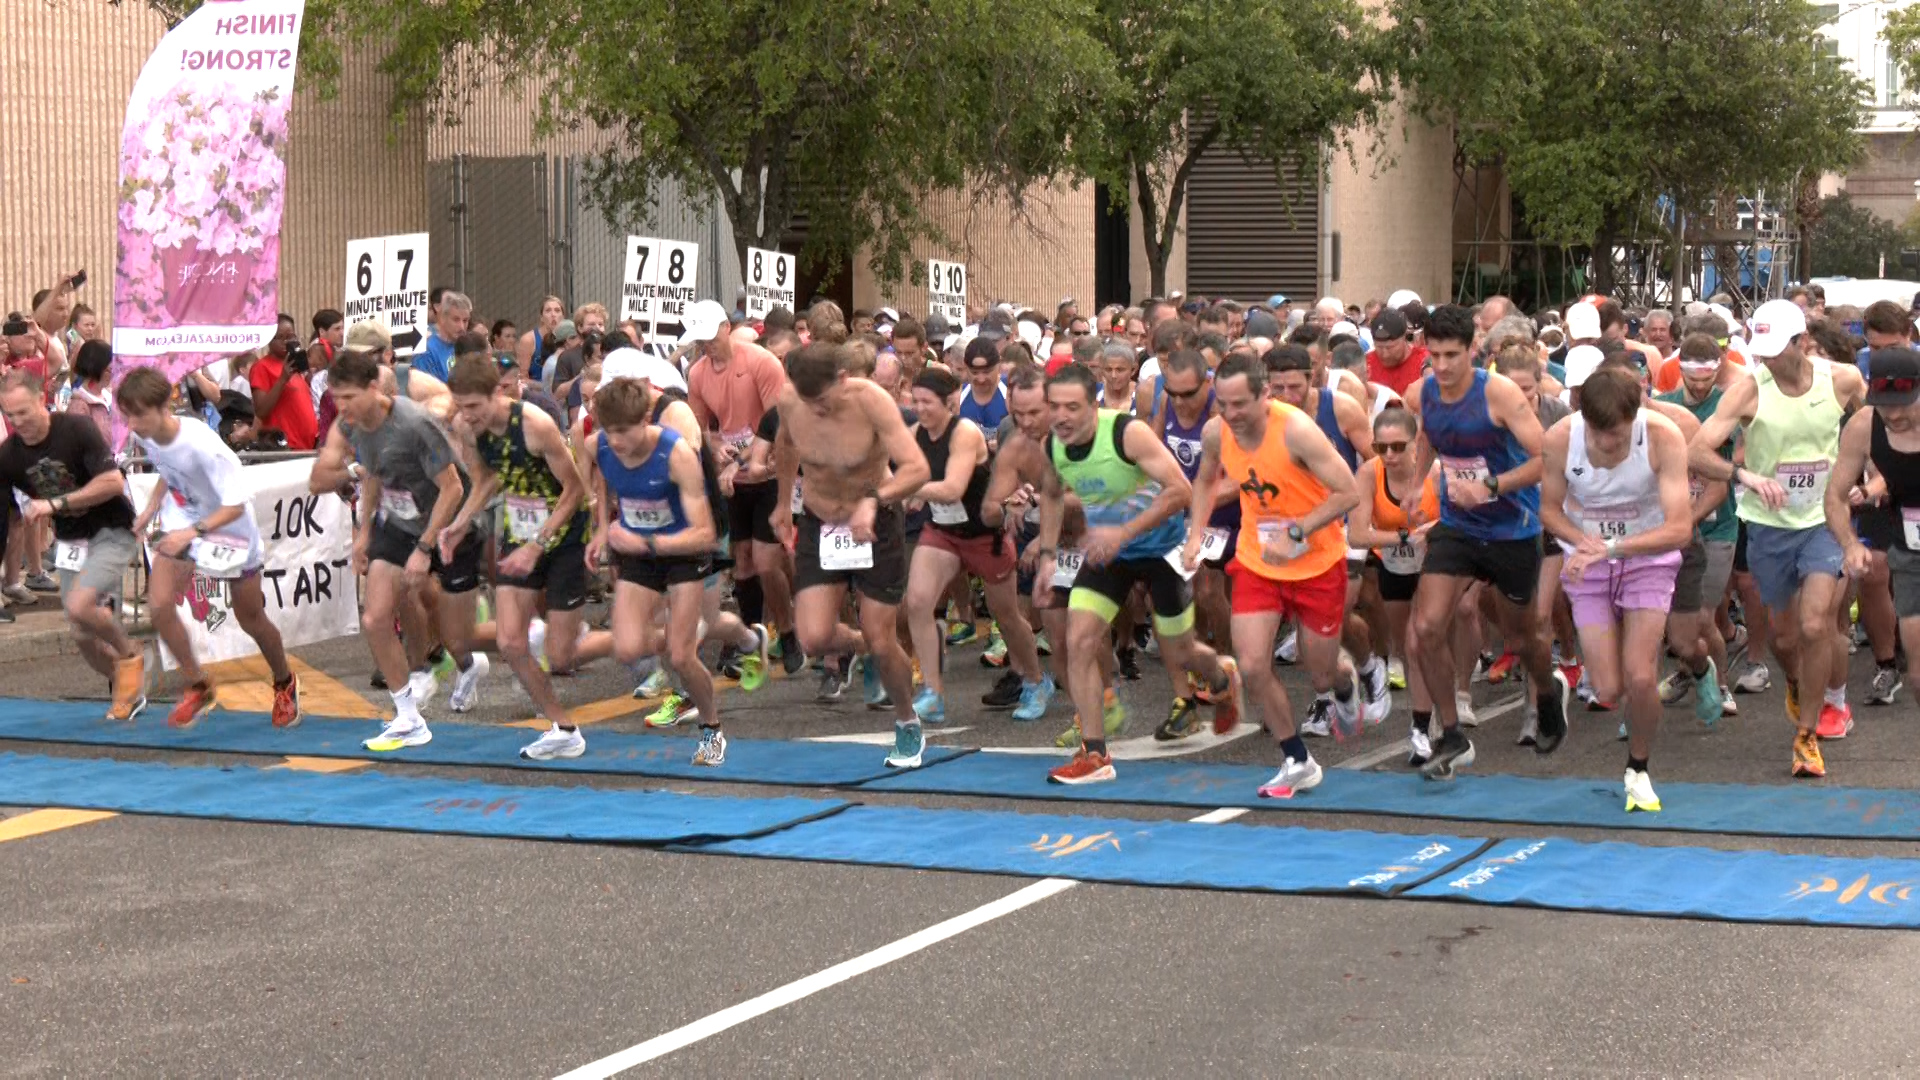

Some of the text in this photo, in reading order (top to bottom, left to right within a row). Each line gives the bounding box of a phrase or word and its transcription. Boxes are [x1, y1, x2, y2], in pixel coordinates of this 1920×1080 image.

[397, 248, 415, 291] 7
[636, 245, 650, 282] 7
[668, 248, 685, 285] 8
[753, 250, 763, 283] 8
[775, 255, 787, 287] 9
[356, 251, 373, 296] 6
[933, 262, 941, 291] 9
[947, 265, 963, 294] 10
[623, 282, 656, 298] MINUTE
[657, 284, 695, 303] MINUTE
[747, 283, 768, 298] MINUTE
[768, 287, 794, 303] MINUTE
[946, 293, 965, 306] MINUTE
[346, 295, 383, 317] MINUTE
[385, 289, 427, 312] MINUTE
[628, 298, 649, 313] MILE
[661, 301, 685, 316] MILE
[750, 297, 764, 311] MILE
[391, 309, 417, 327] MILE
[949, 306, 962, 318] MILE
[1788, 473, 1815, 489] 628
[270, 494, 324, 541] 10K
[834, 535, 866, 550] 85
[1058, 551, 1080, 570] 645
[262, 558, 348, 608] TART
